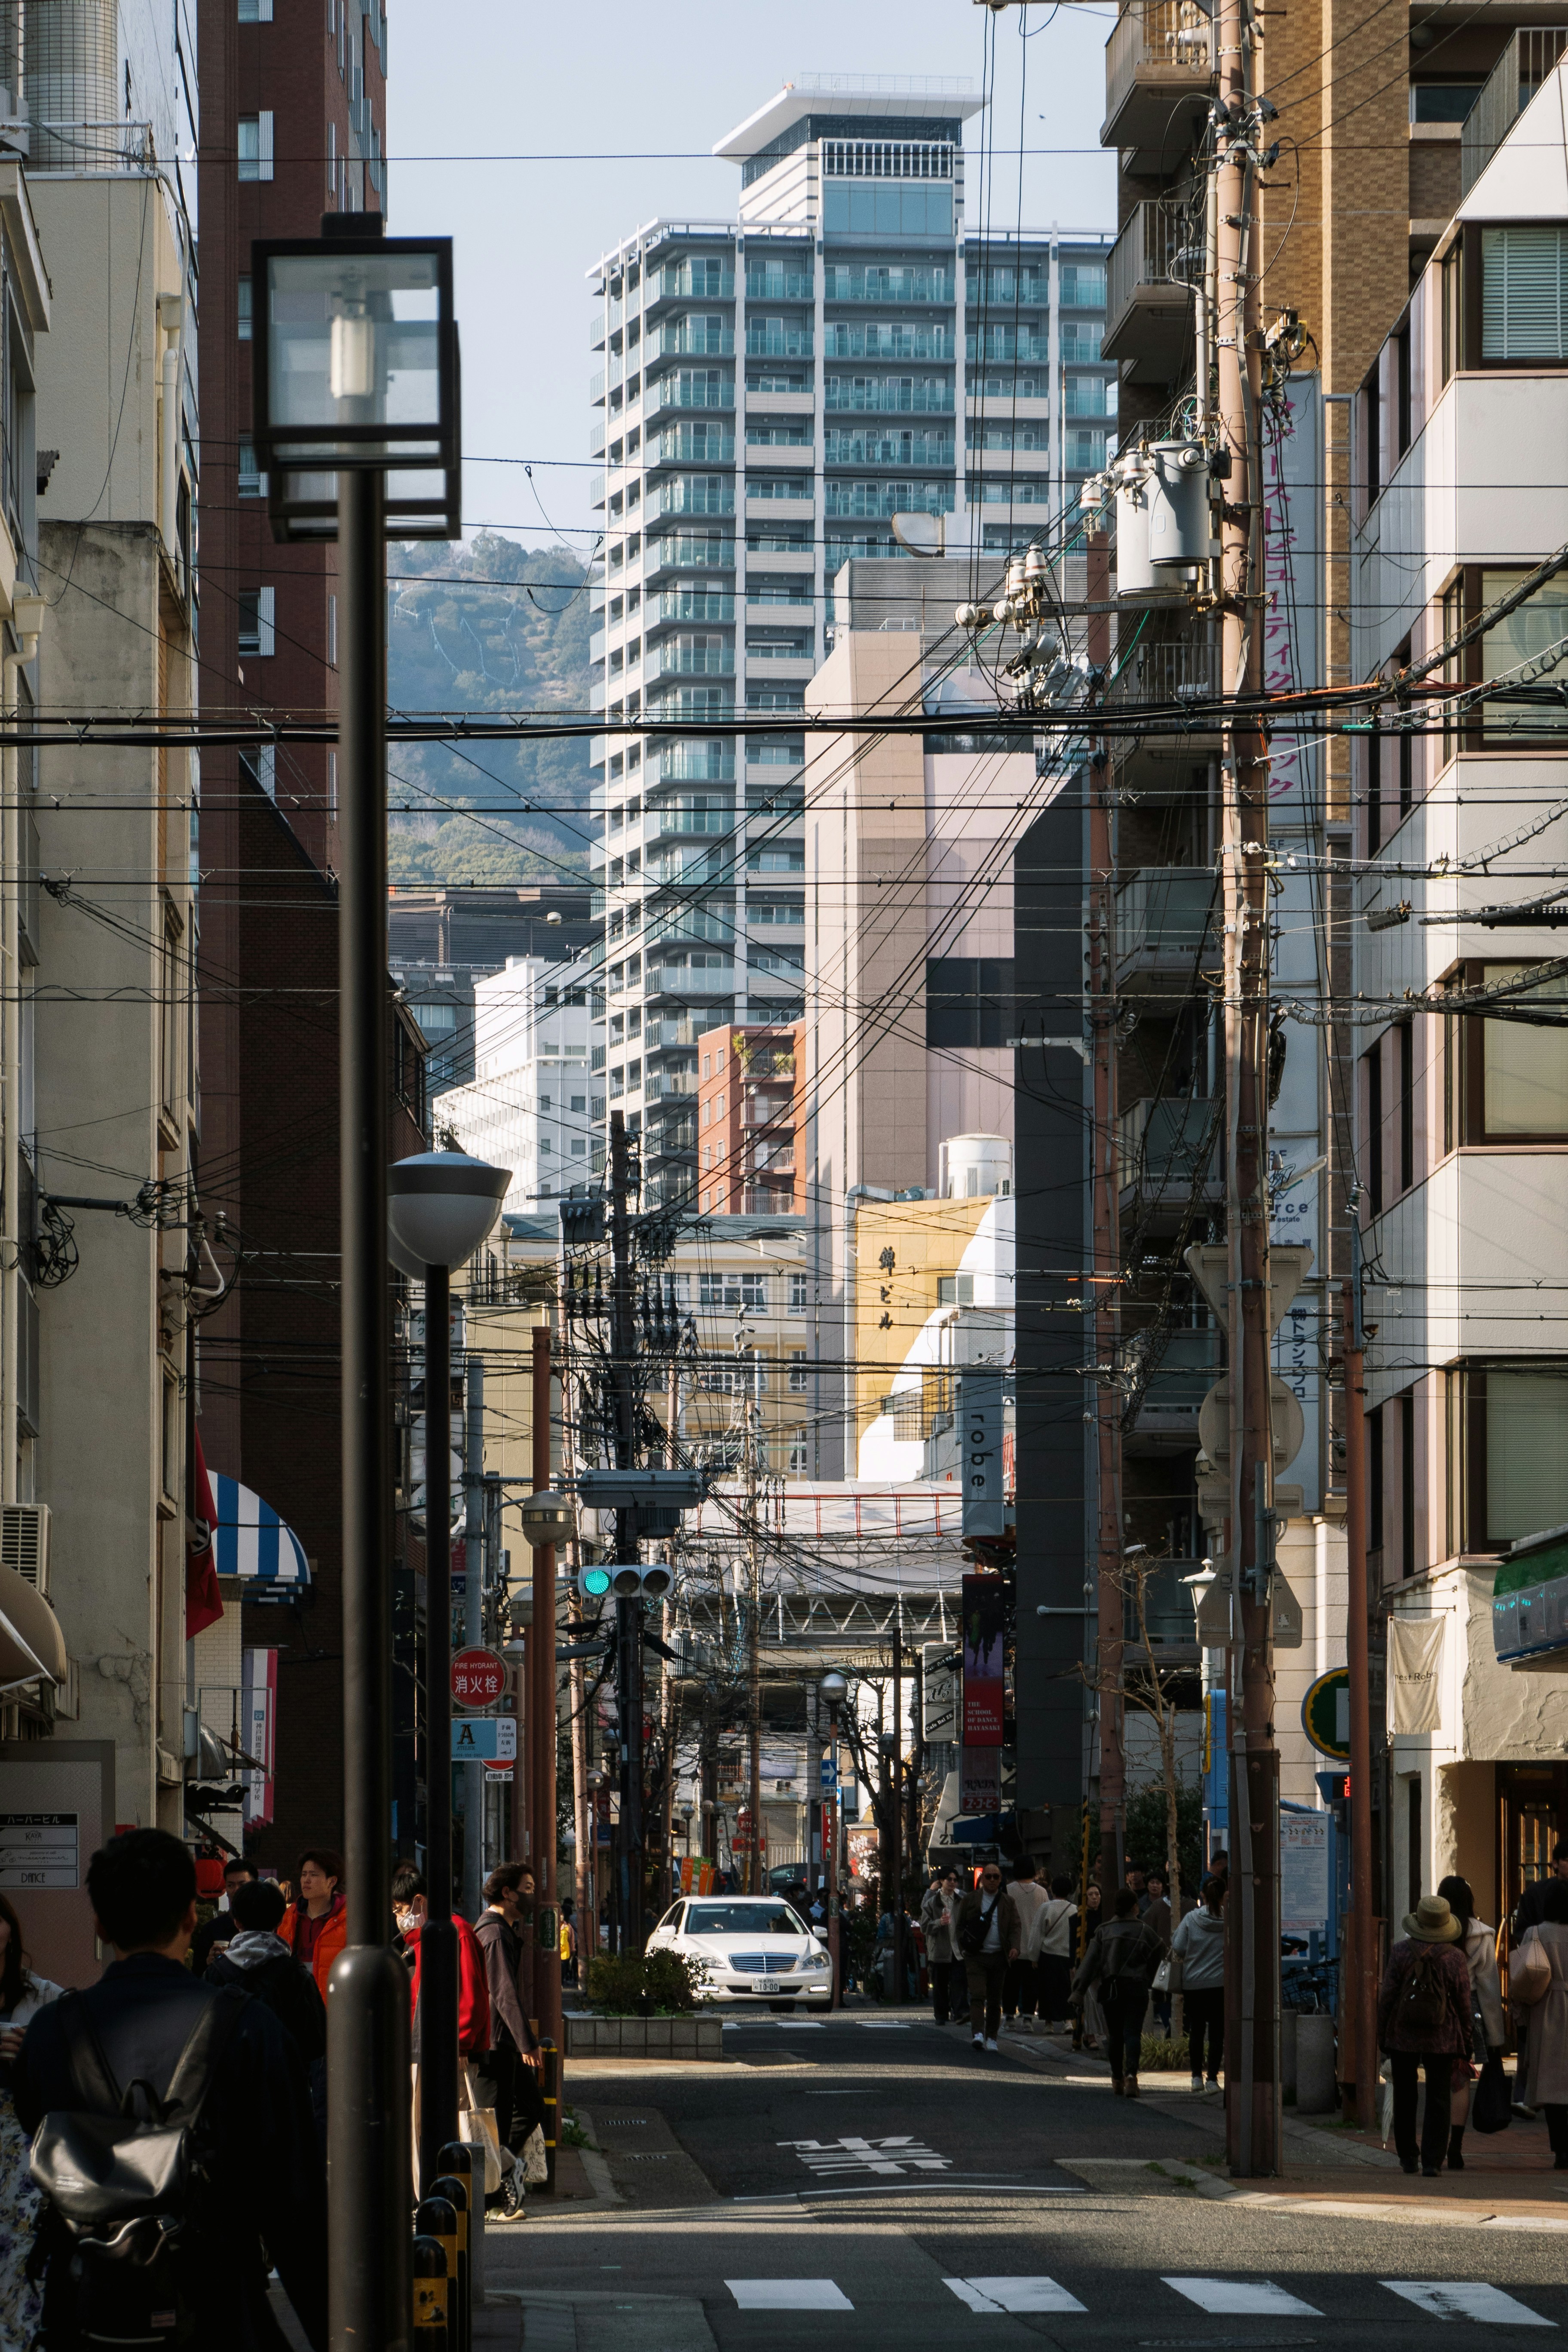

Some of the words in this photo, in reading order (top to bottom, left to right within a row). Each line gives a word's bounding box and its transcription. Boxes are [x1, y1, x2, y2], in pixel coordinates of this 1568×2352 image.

[971, 1415, 993, 1487] robe
[1414, 1671, 1437, 1680] Robe
[455, 1675, 498, 1693] 消火栓
[926, 1722, 937, 1732] Cafe
[456, 1724, 476, 1745] A
[964, 1779, 996, 1791] RAJA
[7, 1816, 60, 1824] ハーバービル
[25, 1832, 43, 1841] KAYA
[21, 1872, 46, 1883] DANCE
[760, 1983, 778, 1991] 10-00
